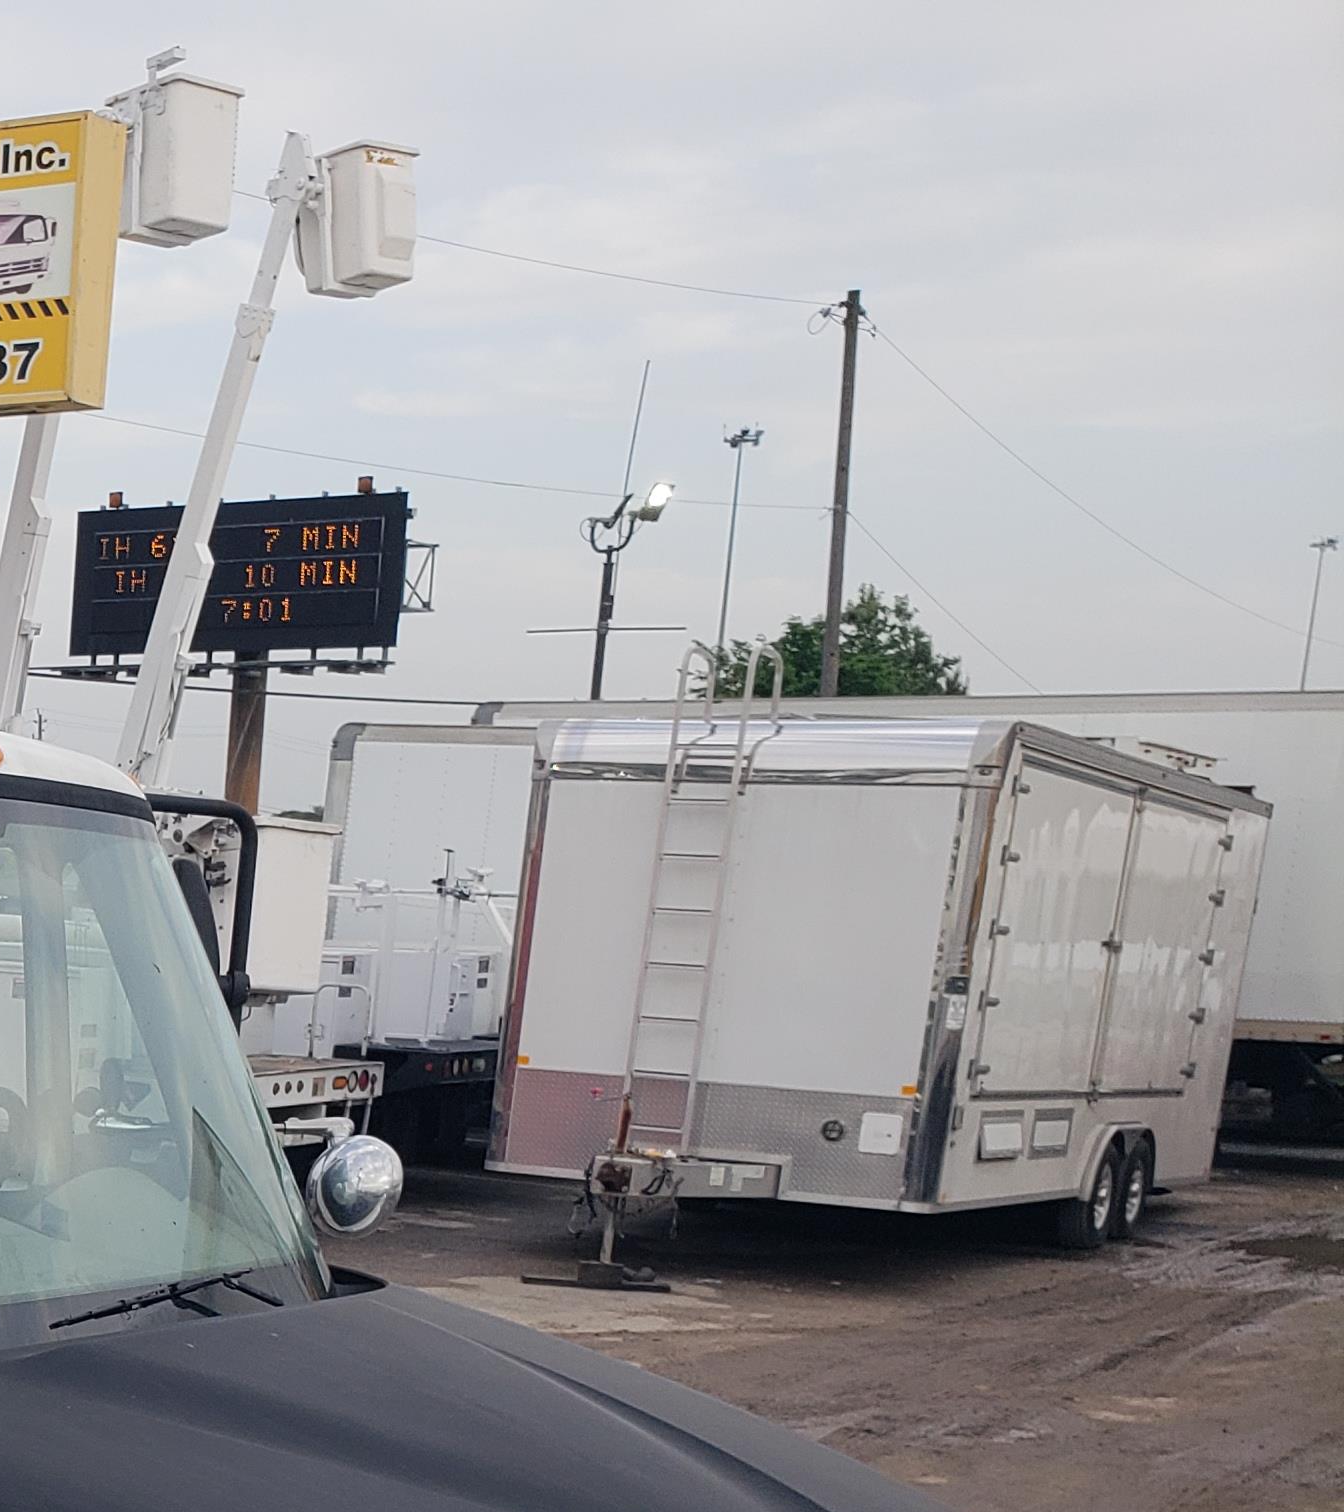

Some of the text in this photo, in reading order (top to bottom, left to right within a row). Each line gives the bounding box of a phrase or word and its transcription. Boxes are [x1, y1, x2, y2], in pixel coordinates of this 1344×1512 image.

[0, 142, 68, 176] Inc.
[150, 534, 178, 559] 6
[264, 524, 359, 553] 7 MIN
[244, 559, 357, 588] 10 MIN
[221, 597, 291, 623] 7:01
